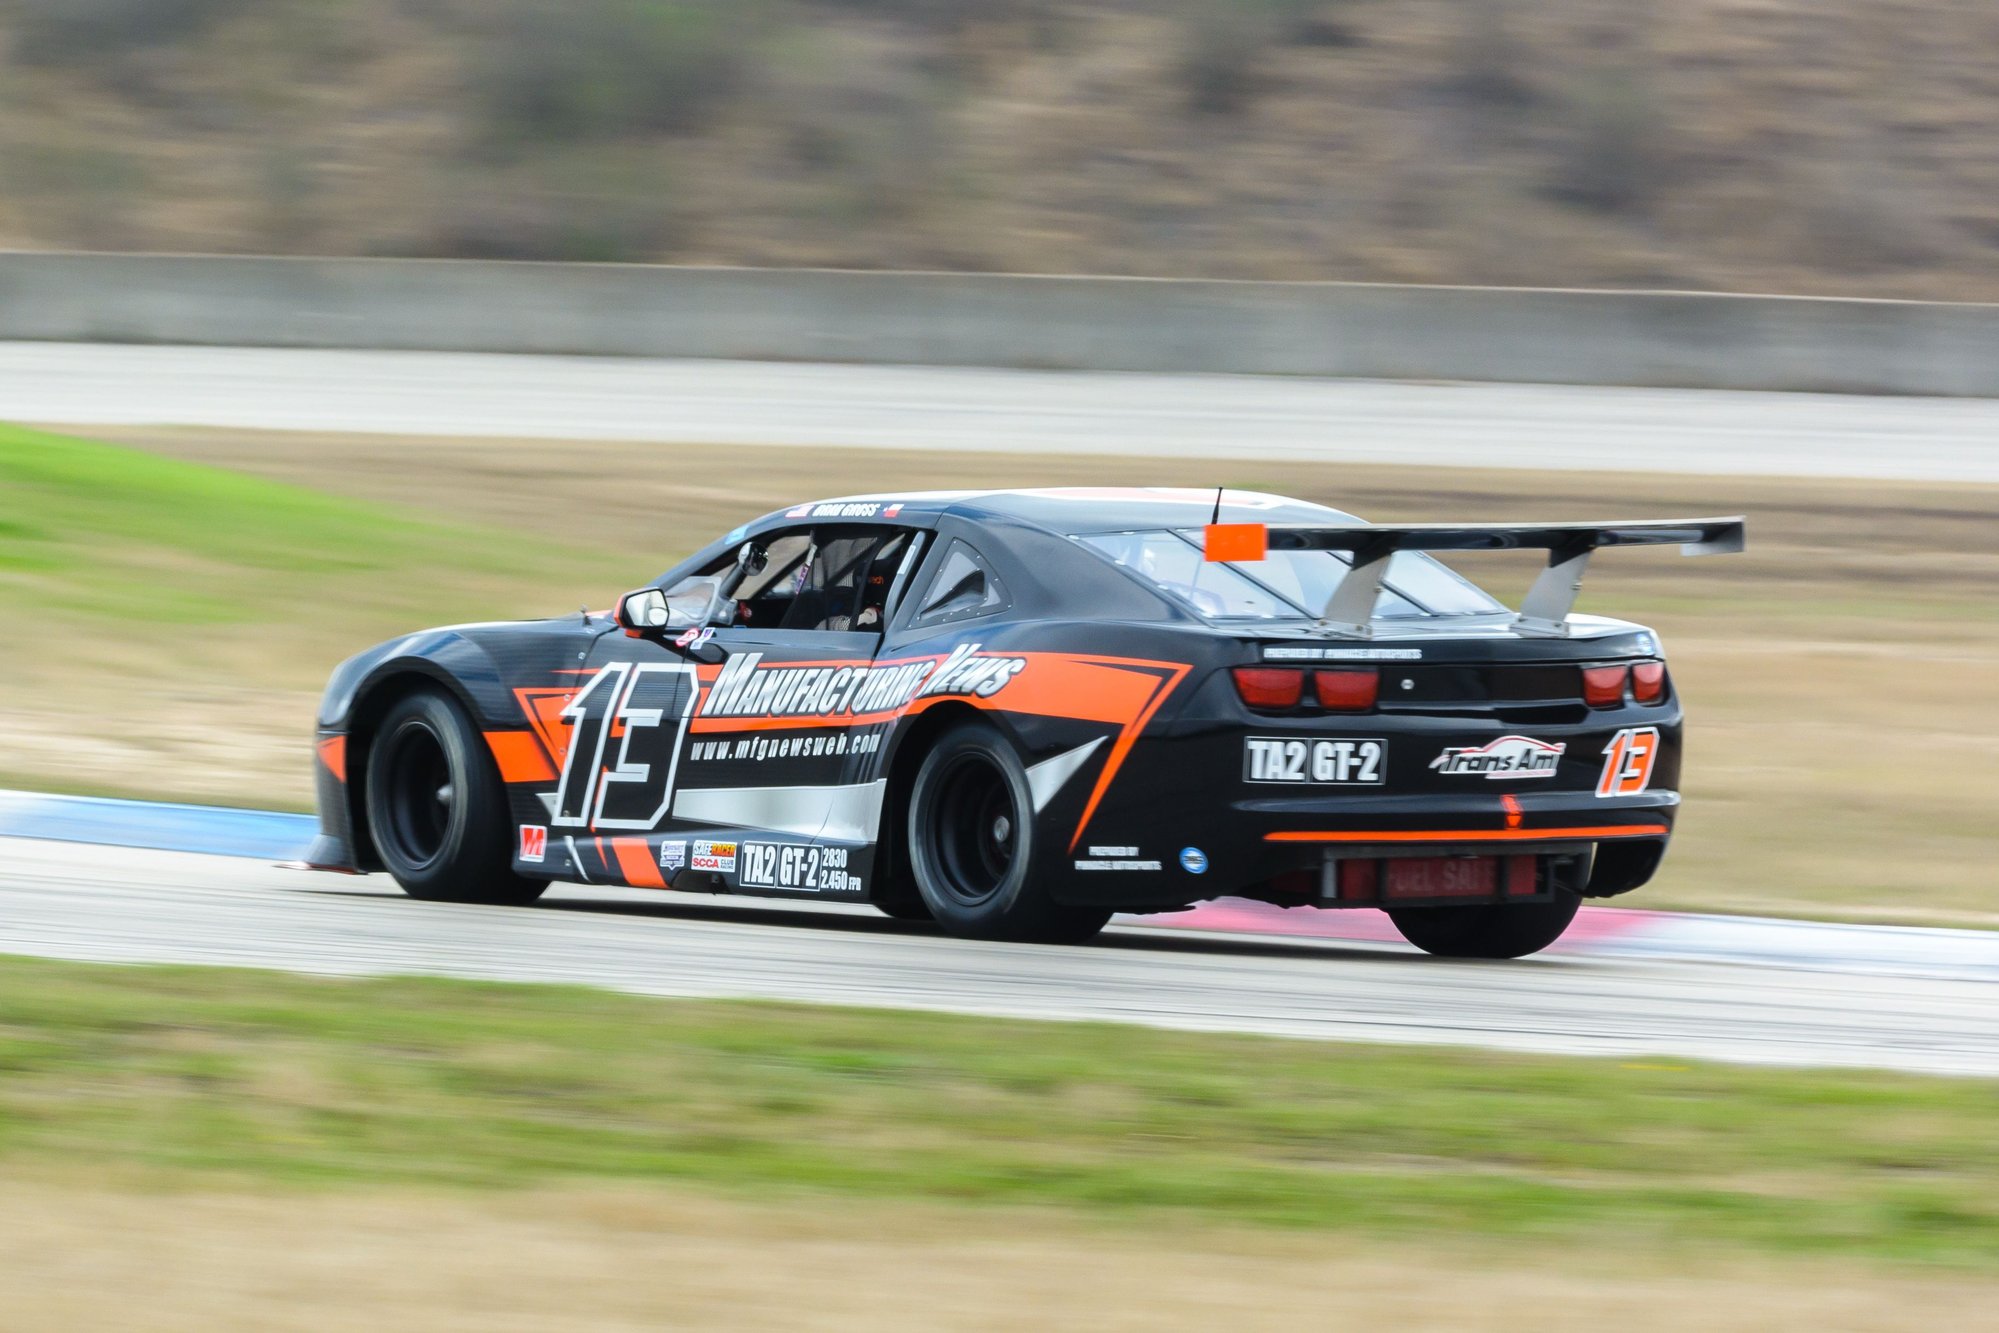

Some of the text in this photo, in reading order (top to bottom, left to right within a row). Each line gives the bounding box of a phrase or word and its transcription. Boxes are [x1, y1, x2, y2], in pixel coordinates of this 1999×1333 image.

[701, 643, 1026, 717] MANUFACTURING NEWS
[550, 661, 701, 830] 13
[690, 732, 881, 762] www.mfgnewsweb.com
[1247, 740, 1379, 782] TA2 GT-2
[1594, 725, 1661, 798] 13
[692, 857, 719, 869] SCCA
[743, 844, 820, 888] TA2 GT-2
[822, 847, 848, 868] 2830
